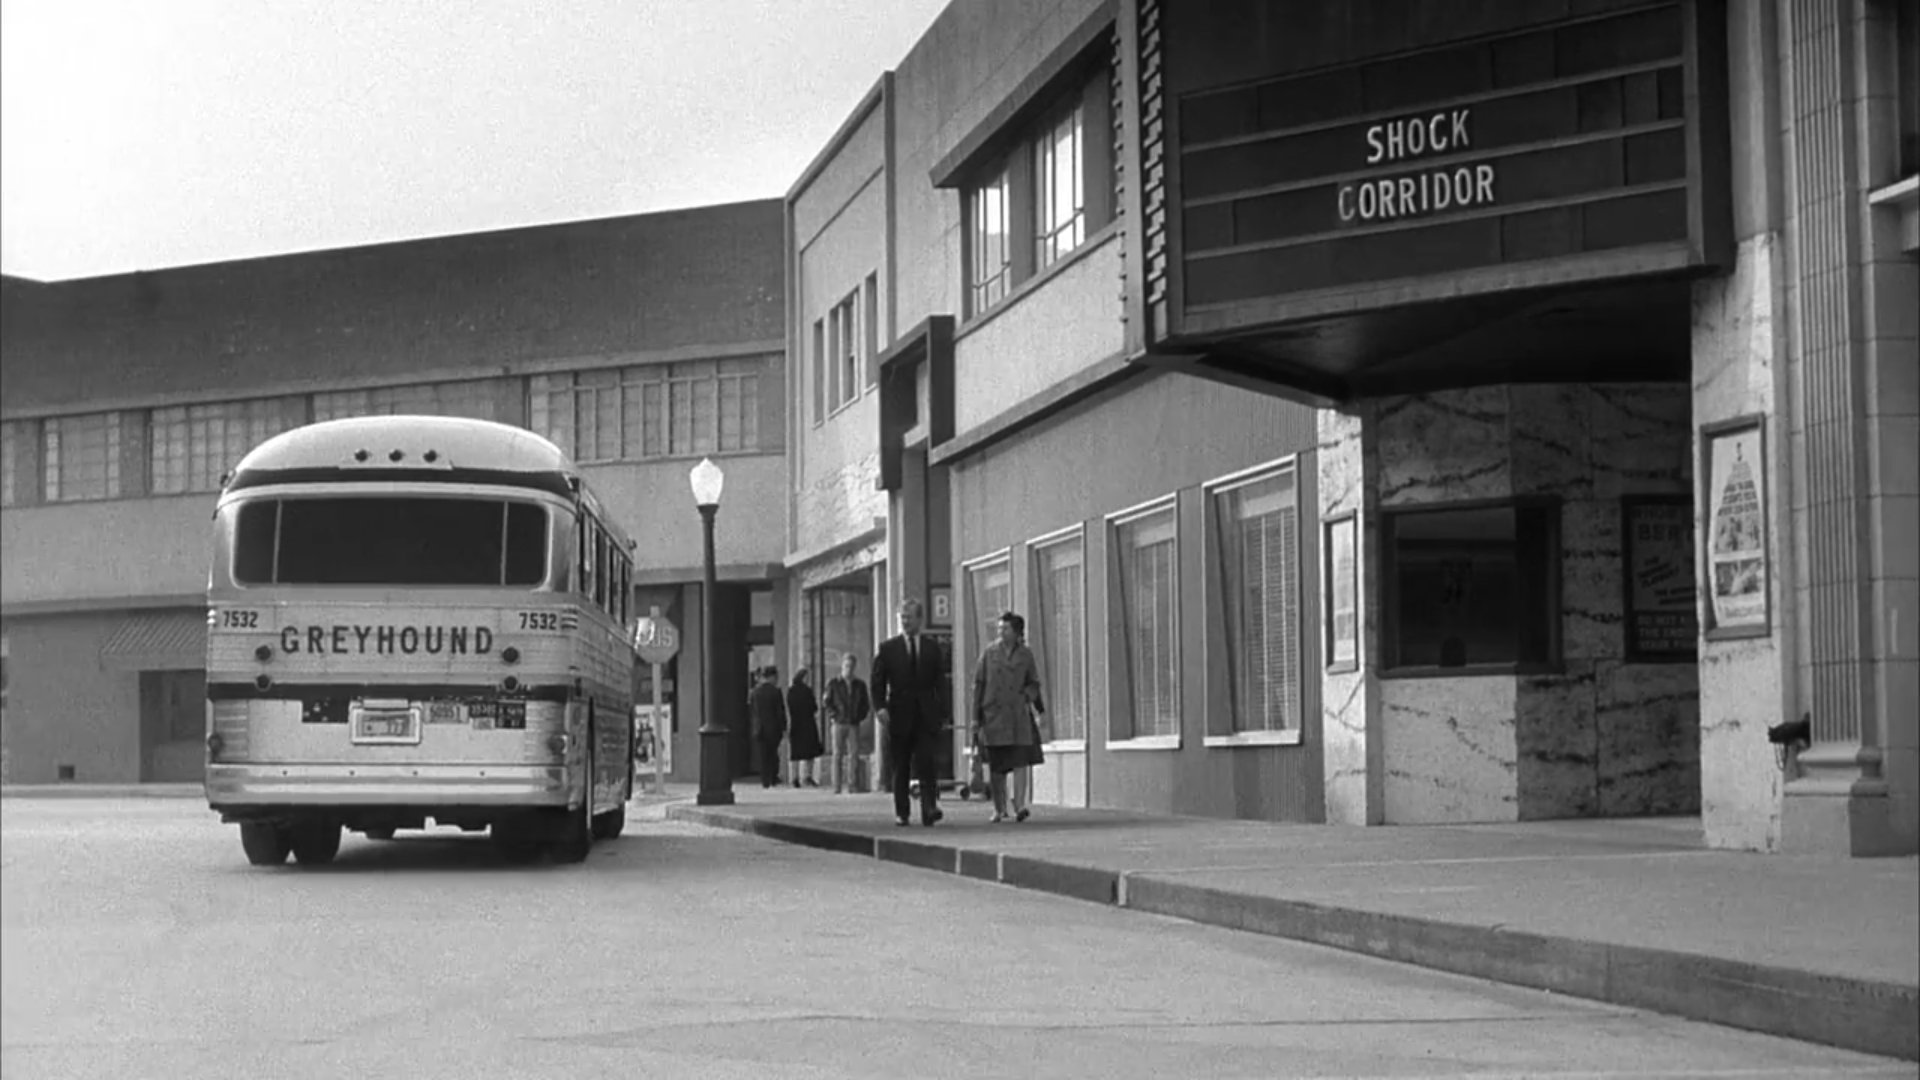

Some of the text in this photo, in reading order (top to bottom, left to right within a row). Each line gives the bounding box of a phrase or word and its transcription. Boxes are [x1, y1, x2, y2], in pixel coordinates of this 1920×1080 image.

[1366, 109, 1469, 163] SHOCK
[1338, 164, 1494, 221] CORRIDOR
[935, 594, 949, 617] B
[223, 610, 259, 628] 7532
[519, 612, 557, 631] 7532
[280, 625, 493, 655] GREYHOUND
